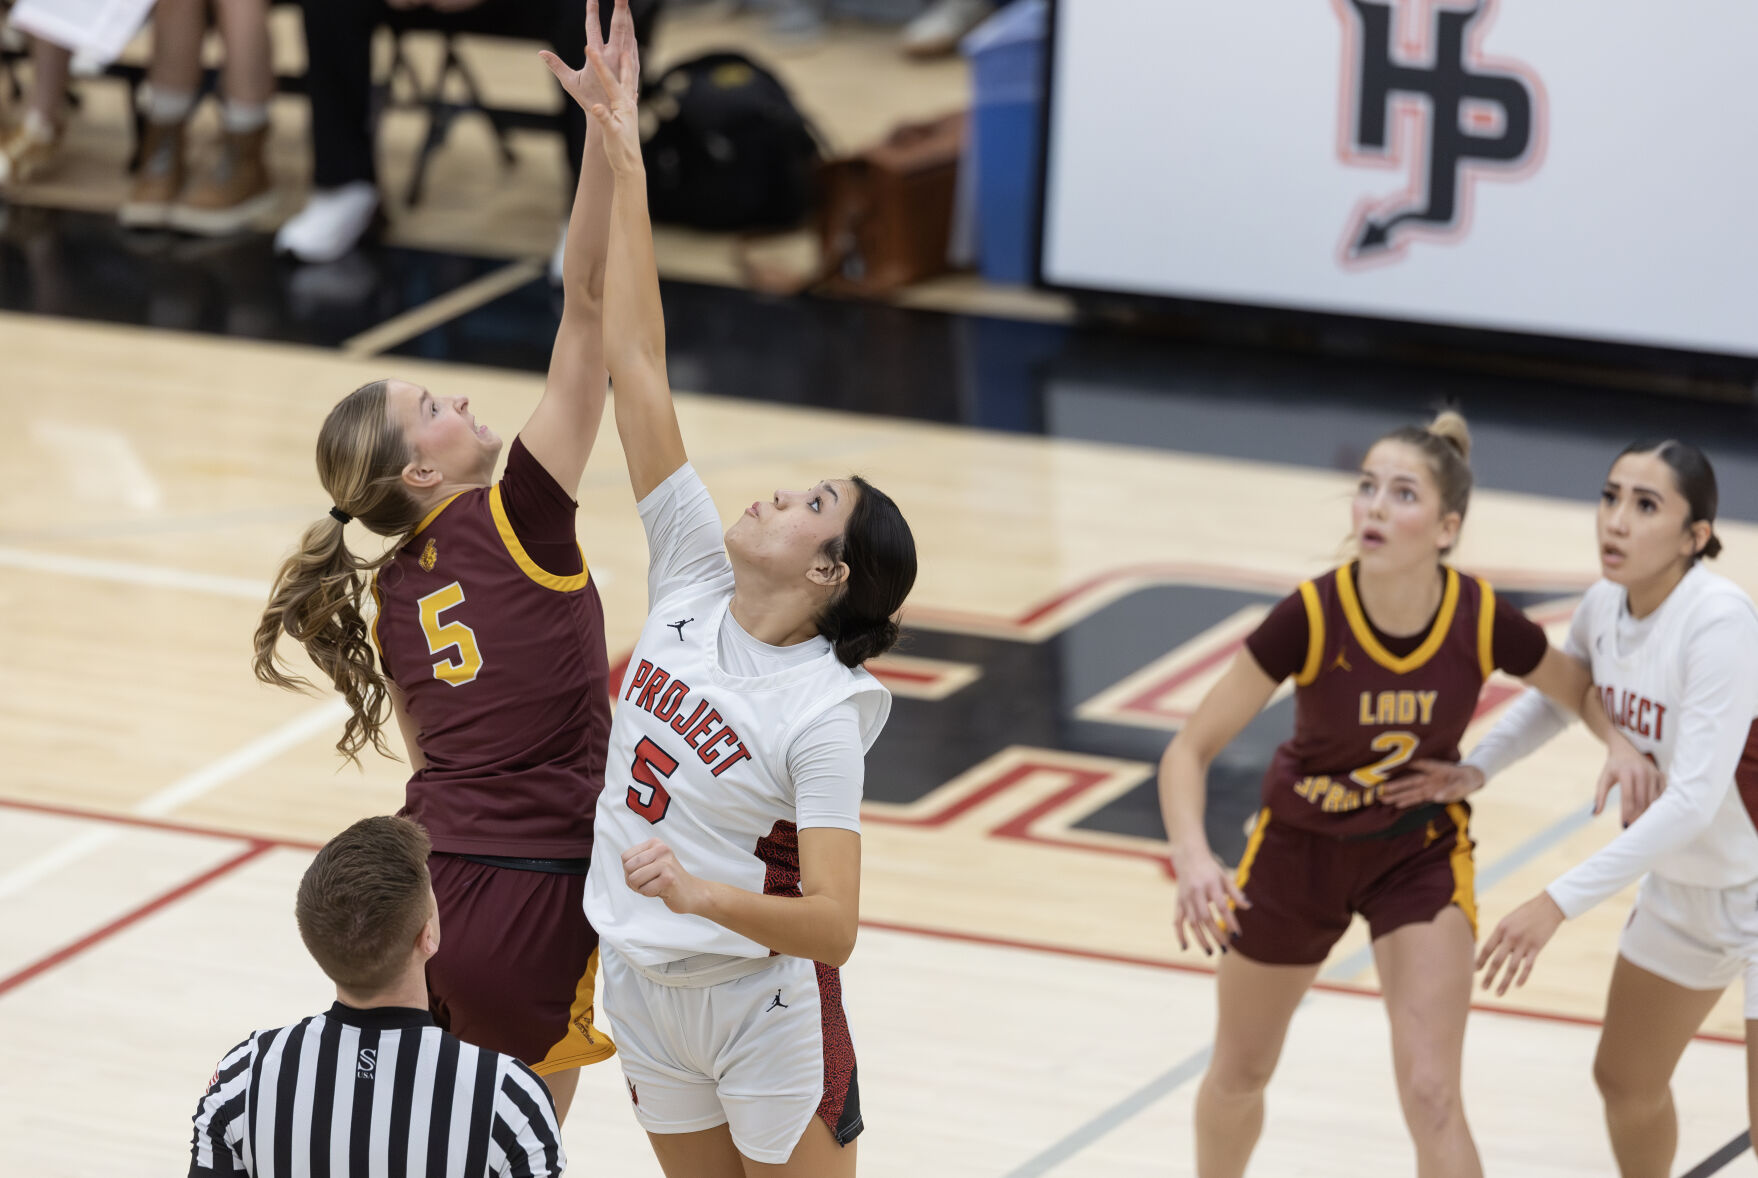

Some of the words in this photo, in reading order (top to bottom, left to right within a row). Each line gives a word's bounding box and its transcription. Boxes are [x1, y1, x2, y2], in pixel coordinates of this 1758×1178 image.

[416, 580, 484, 687] 5
[625, 658, 753, 778] PROJECT
[1359, 690, 1438, 726] LADY
[625, 734, 680, 826] 5
[1349, 730, 1420, 788] 2
[357, 1071, 375, 1080] USA
